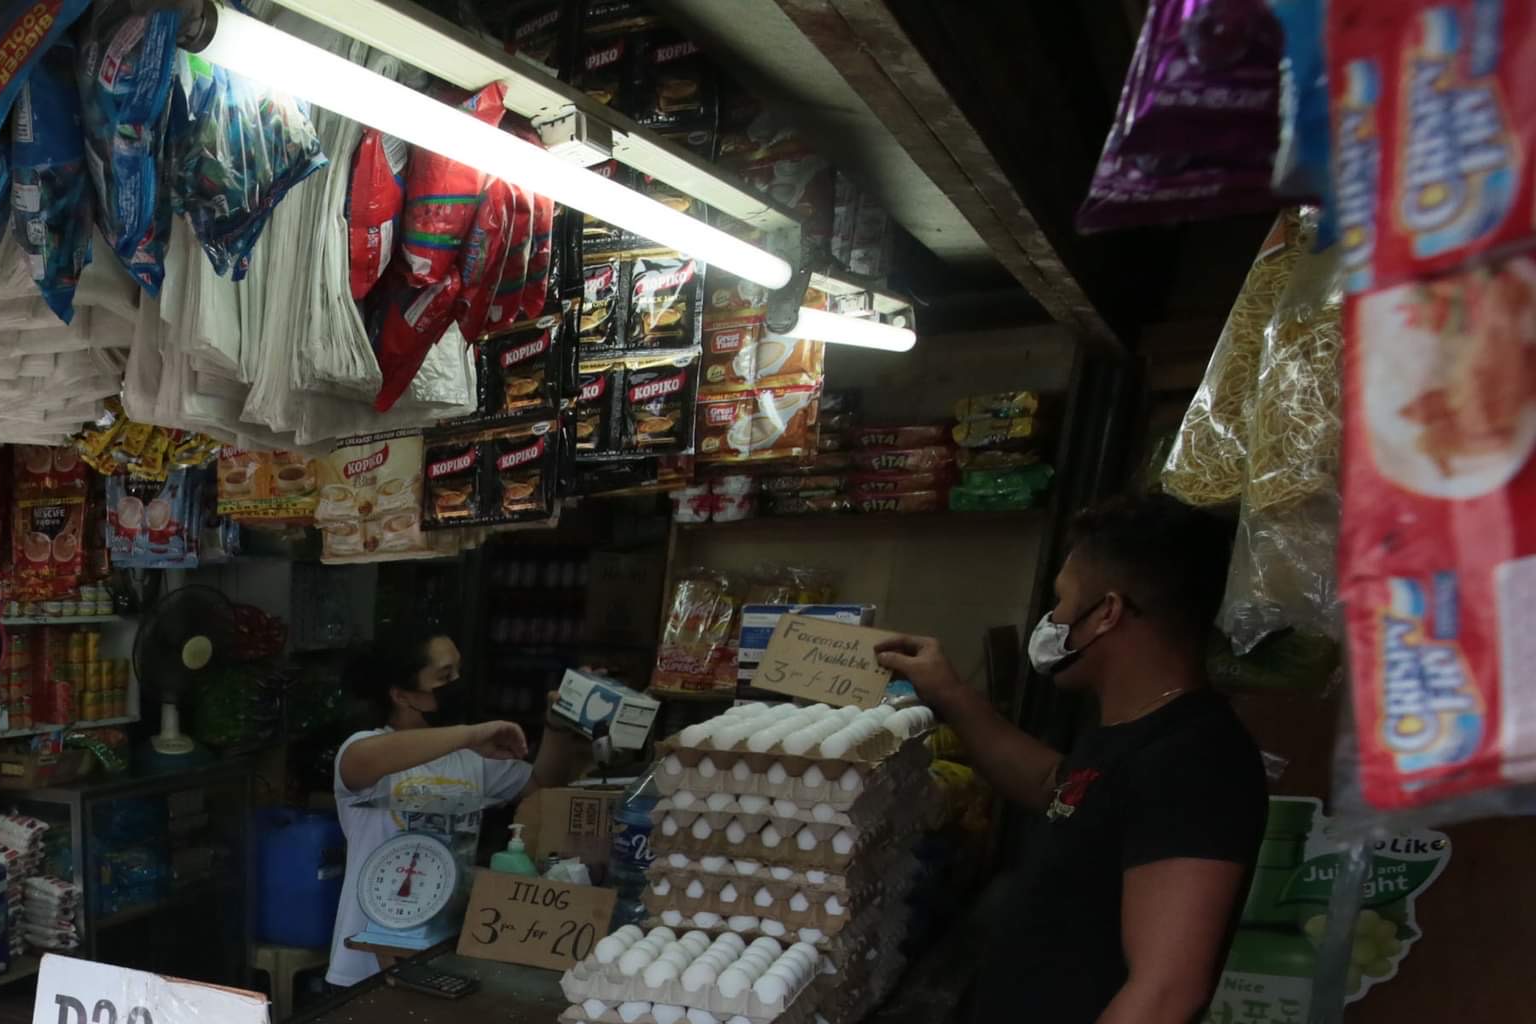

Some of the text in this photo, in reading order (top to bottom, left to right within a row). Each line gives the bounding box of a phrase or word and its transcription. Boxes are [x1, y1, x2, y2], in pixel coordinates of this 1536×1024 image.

[585, 48, 619, 70] PIKO
[504, 338, 544, 365] KOPIKO
[633, 376, 681, 399] KOPIKO
[431, 454, 472, 476] KOPIKO
[500, 446, 540, 469] KOPIKO
[764, 659, 790, 684] 3
[1378, 862, 1406, 874] and
[507, 880, 572, 911] ITLOG
[1362, 874, 1410, 899] ght
[471, 906, 501, 945] 3
[519, 919, 549, 944] for
[550, 919, 596, 962] 20
[1223, 976, 1265, 994] Nice
